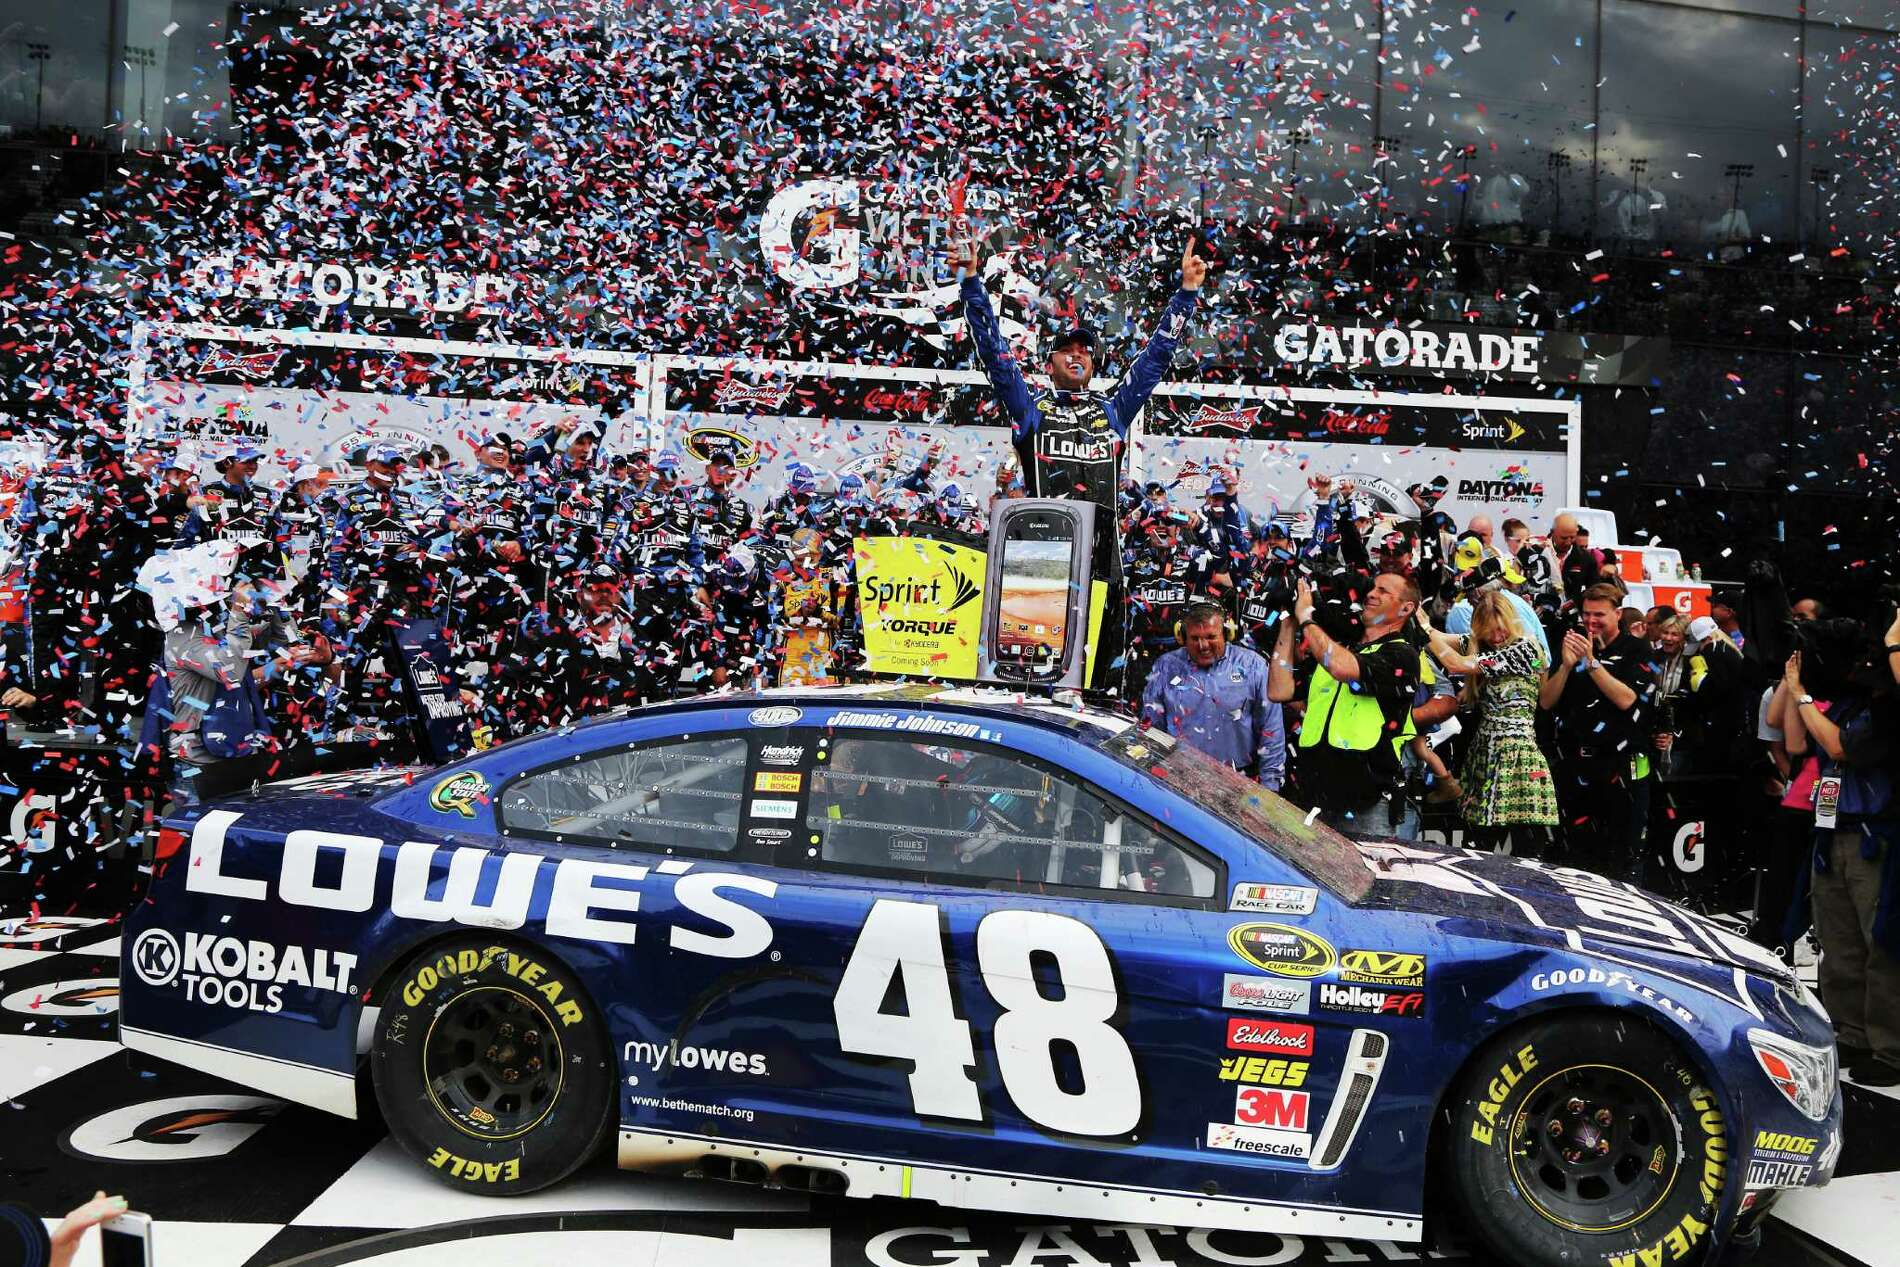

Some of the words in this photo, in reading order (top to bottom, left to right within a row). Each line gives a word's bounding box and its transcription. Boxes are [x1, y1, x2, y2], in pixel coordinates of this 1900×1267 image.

[1275, 324, 1540, 374] GATORADE
[1462, 422, 1505, 441] Sprint
[1458, 480, 1544, 497] DAYTONA
[864, 575, 942, 615] Sprint
[1674, 591, 1692, 613] G
[881, 619, 958, 636] TORQUE
[891, 656, 920, 667] Coming
[827, 710, 893, 728] Jimmie
[896, 713, 980, 737] Johnson
[760, 745, 805, 757] Hendrick
[448, 779, 492, 793] QUAKER
[770, 782, 797, 790] BOSCH
[755, 804, 793, 813] SIEMENS
[1673, 822, 1704, 872] G
[186, 809, 779, 959] LOWE'S
[1263, 887, 1305, 901] NASCAR
[1235, 900, 1275, 909] RACE
[1276, 903, 1306, 912] CAR
[1258, 932, 1300, 944] NASCAR
[183, 931, 358, 994] KOBALT
[1264, 943, 1300, 959] Sprint
[1267, 962, 1289, 970] CUP
[1288, 963, 1324, 974] SERIES
[1342, 970, 1394, 986] MECHANIX
[1394, 974, 1424, 987] WEAR
[182, 973, 283, 1014] TOOLS
[402, 946, 584, 1028] GOODYEAR
[1229, 981, 1265, 997] Coors
[1264, 990, 1304, 1001] LIGHT
[1320, 983, 1386, 1013] Holley
[1531, 967, 1694, 1025] GOODYEAR
[1238, 998, 1294, 1010] POLE
[833, 899, 1141, 1136] 48
[1232, 1025, 1308, 1049] Edelbrock
[1218, 1056, 1311, 1087] JEGS
[1470, 1043, 1540, 1147] EAGLE
[631, 1094, 755, 1122] www.bethematch.org
[1237, 1089, 1308, 1129] 3M
[1234, 1137, 1304, 1157] freescale
[1753, 1130, 1819, 1155] MOOG
[427, 1147, 521, 1183] EAGLE
[1607, 1086, 1729, 1267] GOODYEA
[1746, 1161, 1811, 1186] MAHLE
